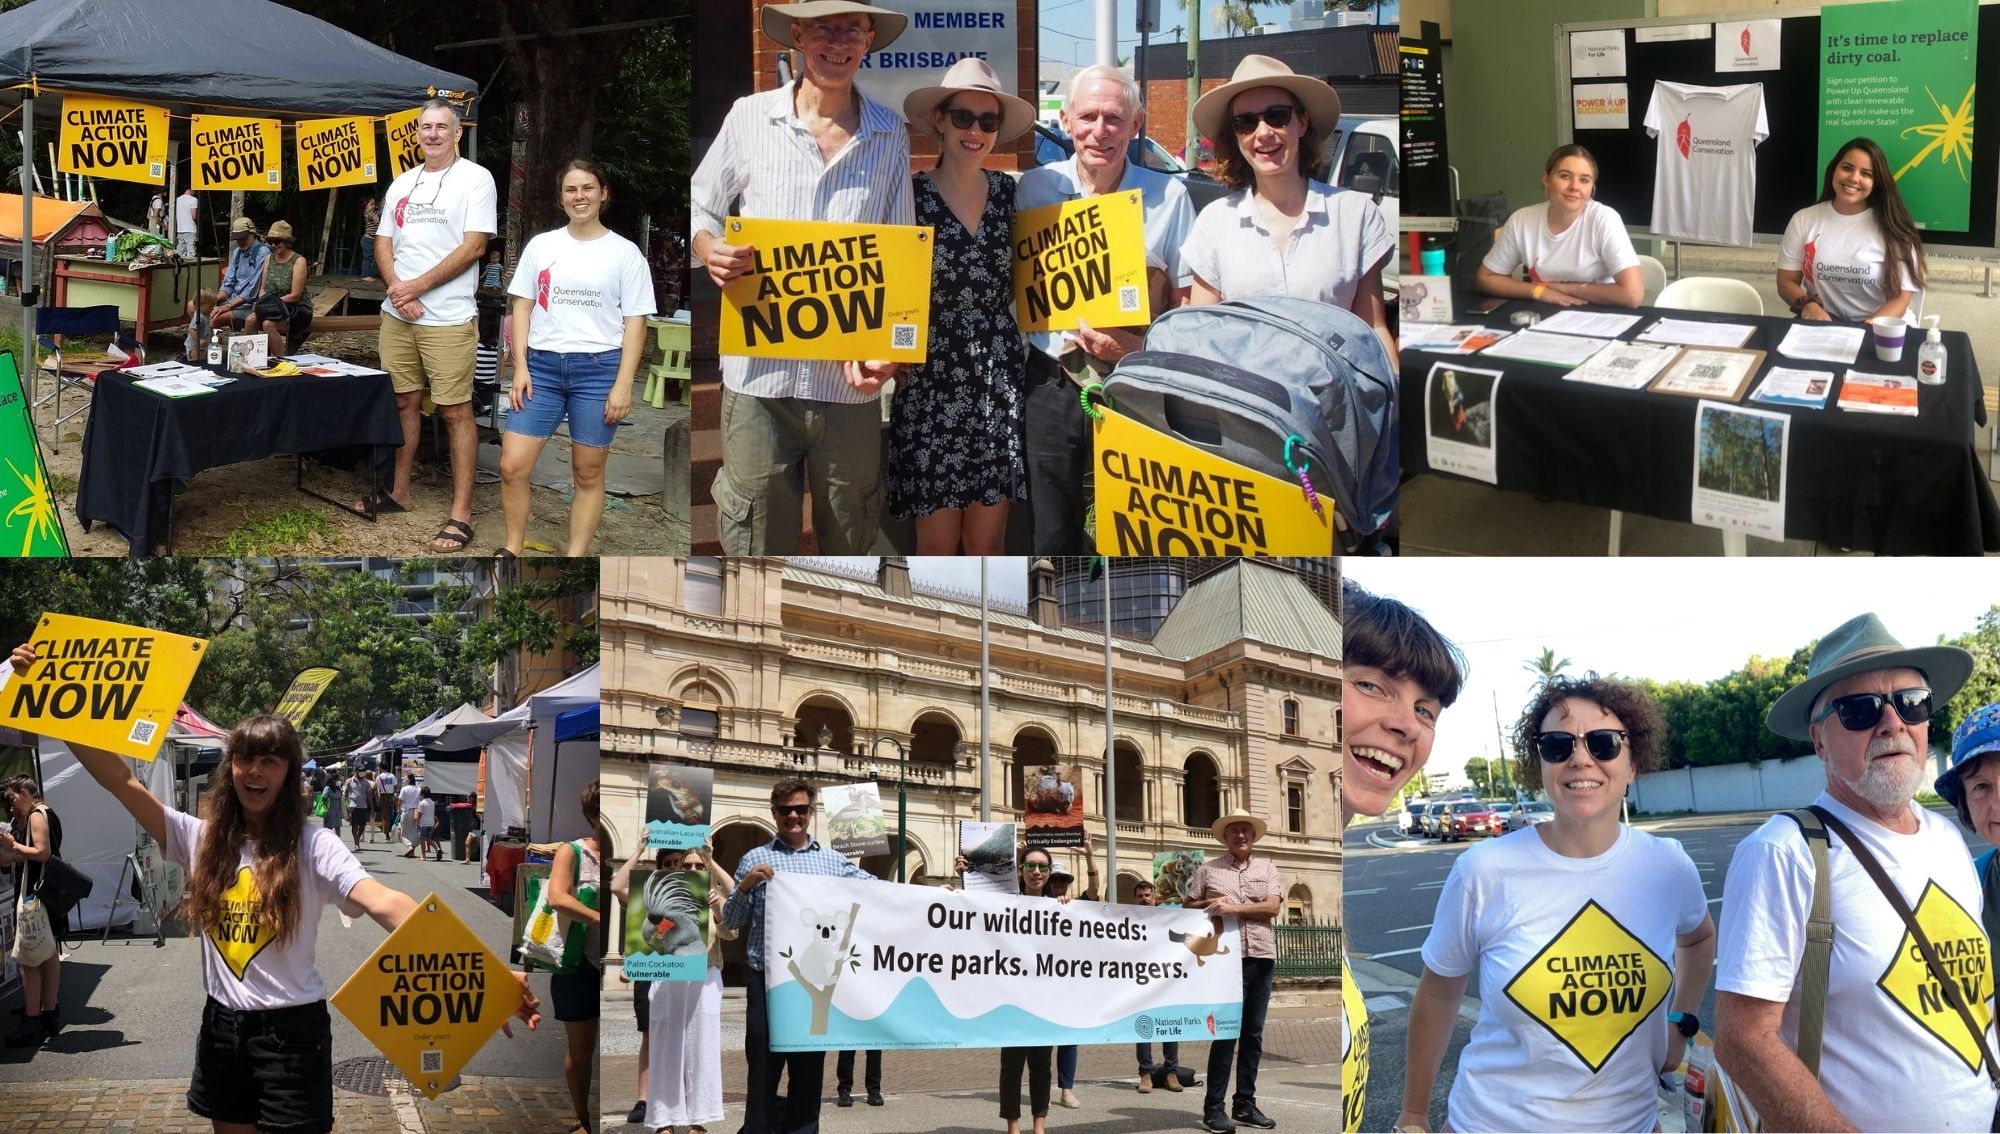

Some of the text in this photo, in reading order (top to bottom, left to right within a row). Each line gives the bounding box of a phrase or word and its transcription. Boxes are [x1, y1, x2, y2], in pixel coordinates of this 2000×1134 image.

[914, 12, 1005, 29] MEMBER
[1828, 30, 1969, 48] It's time to replace
[1827, 50, 1901, 66] dirty coal.
[1826, 77, 1843, 86] Sign
[1858, 76, 1888, 85] petition
[1826, 86, 1909, 96] Power Up Queensland
[1576, 98, 1626, 107] POWER UP
[1844, 97, 1864, 105] clean
[1865, 96, 1905, 105] renewable
[67, 108, 146, 126] CLIMATE
[1825, 109, 1851, 117] energy
[1852, 107, 1867, 115] and
[1868, 107, 1889, 115] make
[1900, 107, 1914, 115] the
[1825, 118, 1899, 126] real Sunshine State!
[80, 124, 148, 142] ACTION
[195, 122, 261, 147] CLIMATE
[300, 121, 357, 151] CLIMATE
[391, 118, 419, 142] CLIM
[208, 136, 264, 160] ACTION
[312, 134, 360, 161] ACTION
[1692, 137, 1731, 147] Queensland
[1692, 146, 1735, 156] Conservation
[71, 140, 149, 169] NOW
[398, 143, 426, 173] NO
[201, 151, 265, 186] NOW
[306, 147, 362, 186] NOW
[406, 216, 448, 225] Conservation
[1017, 204, 1103, 261] CLIMATE
[741, 234, 880, 276] LIMATE
[1033, 228, 1109, 281] ACTION
[1816, 262, 1871, 275] Queensland
[1816, 272, 1876, 286] Conservation
[757, 260, 886, 301] ACTION
[1025, 253, 1112, 324] NOW
[741, 287, 886, 348] NOW
[1101, 449, 1260, 514] CLIMATE
[1127, 487, 1268, 549] ACTION
[33, 637, 155, 660] CLIMATE
[36, 660, 150, 682] ACTION
[9, 682, 144, 721] NOW
[832, 841, 850, 849] Beach
[1051, 837, 1081, 845] Endangered
[218, 922, 260, 944] NOW
[927, 902, 1148, 942] Our wildlife needs:
[1910, 937, 1986, 963] CMATE
[378, 952, 484, 974] CLIMATE
[626, 969, 671, 979] Vulnerable
[627, 960, 685, 969] Palm Cockatoo
[873, 944, 1189, 986] More parks. More rangers.
[1546, 953, 1644, 973] CLIMATE
[1925, 955, 1986, 982] ATION
[393, 972, 485, 993] ACTION
[1561, 969, 1647, 991] ACTION
[380, 992, 485, 1027] NOW
[1548, 986, 1647, 1019] NOW
[1154, 1016, 1202, 1026] National Parks
[1155, 1026, 1182, 1036] For Life
[413, 1033, 451, 1042] Order yours
